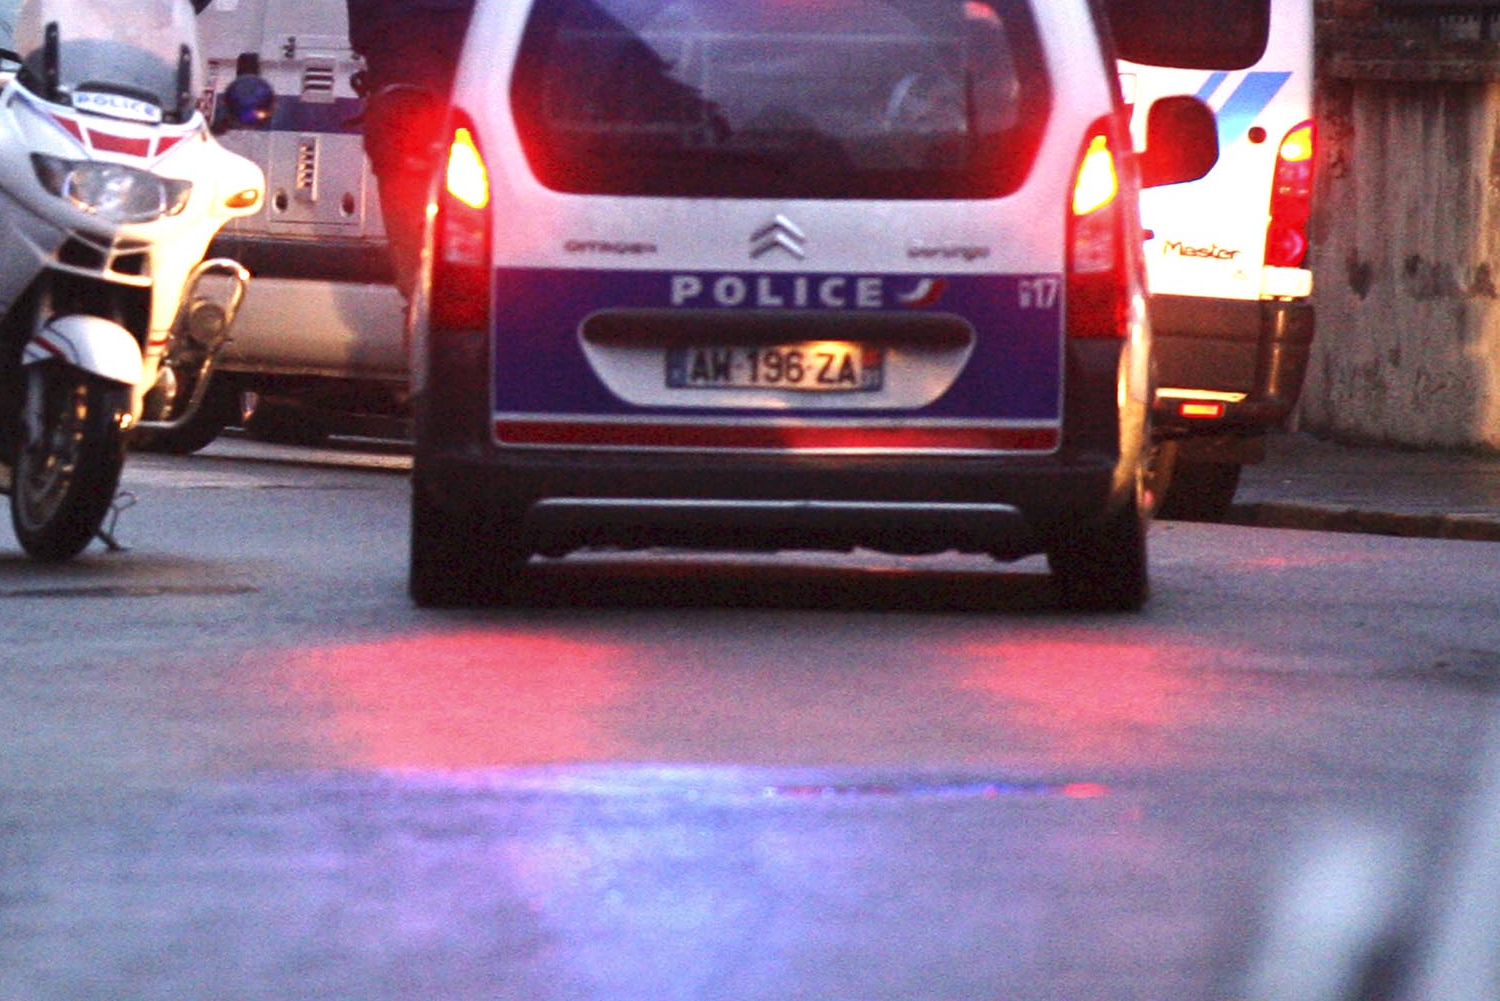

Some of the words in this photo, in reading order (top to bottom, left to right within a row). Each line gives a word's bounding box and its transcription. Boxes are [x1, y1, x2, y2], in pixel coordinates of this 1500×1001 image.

[78, 93, 155, 117] POLICE
[1162, 239, 1242, 260] Master
[670, 275, 883, 308] POLICE
